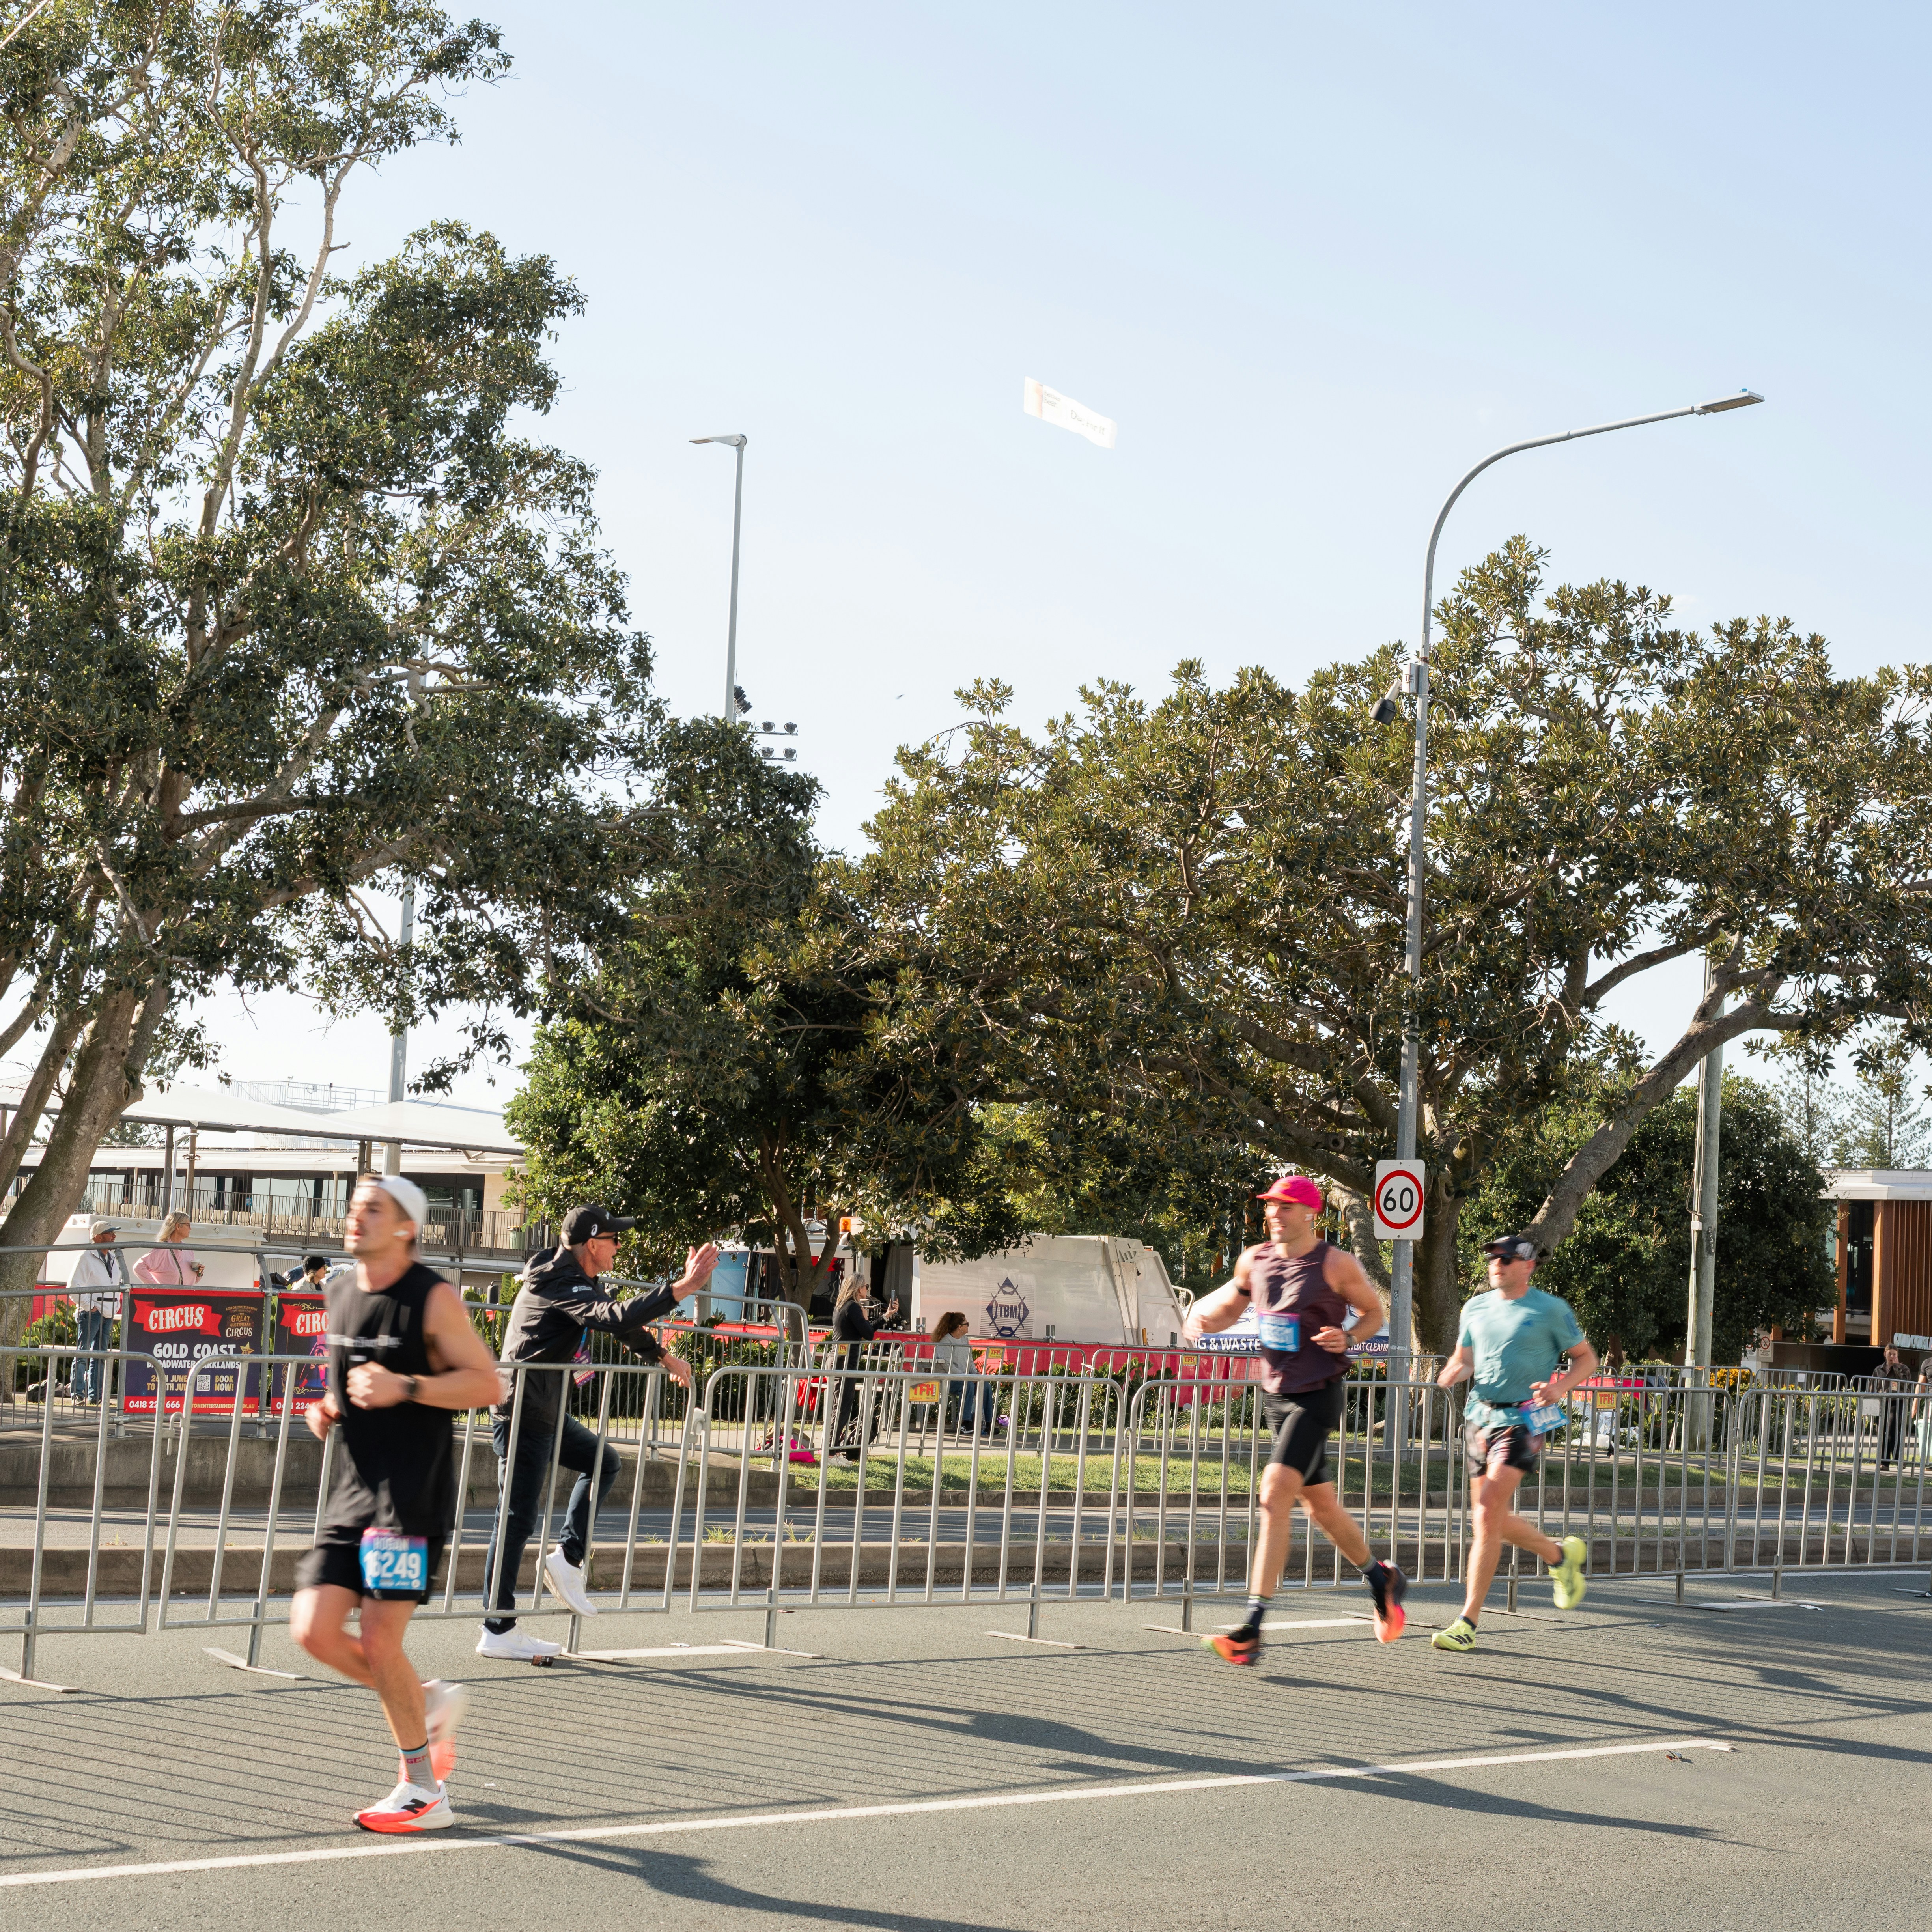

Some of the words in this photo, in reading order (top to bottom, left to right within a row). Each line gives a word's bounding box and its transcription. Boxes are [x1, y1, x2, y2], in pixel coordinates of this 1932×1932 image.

[1383, 1187, 1413, 1212] 60
[999, 1304, 1017, 1318] TBM
[149, 1307, 204, 1331] CIRCUS
[226, 1327, 252, 1338] CIRCUS
[1209, 1337, 1218, 1350] &
[1220, 1338, 1262, 1351] WASTE
[1893, 1333, 1910, 1348] GOLD
[153, 1343, 189, 1358] GOLD
[193, 1344, 236, 1358] COAST
[914, 1384, 934, 1395] TFH
[1599, 1394, 1613, 1404] TFH
[364, 1550, 421, 1579] 16249
